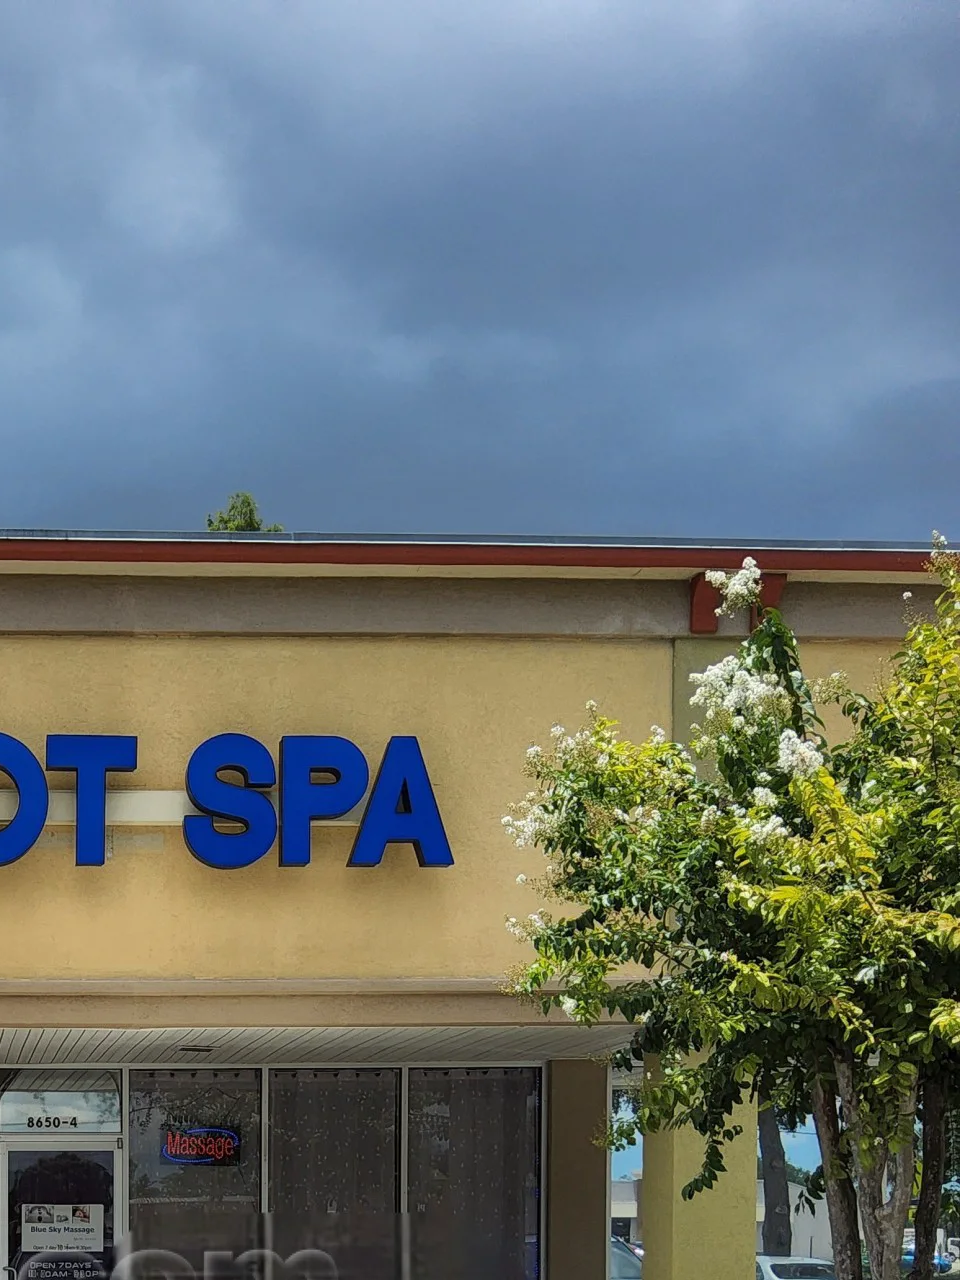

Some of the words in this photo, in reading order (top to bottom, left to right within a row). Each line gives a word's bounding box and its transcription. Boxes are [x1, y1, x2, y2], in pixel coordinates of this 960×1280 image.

[183, 732, 454, 869] SPA
[27, 1116, 78, 1129] 8650-4
[167, 1131, 235, 1160] Massage
[49, 1226, 61, 1234] Sky
[63, 1226, 95, 1234] Massage
[29, 1261, 56, 1270] OPEN
